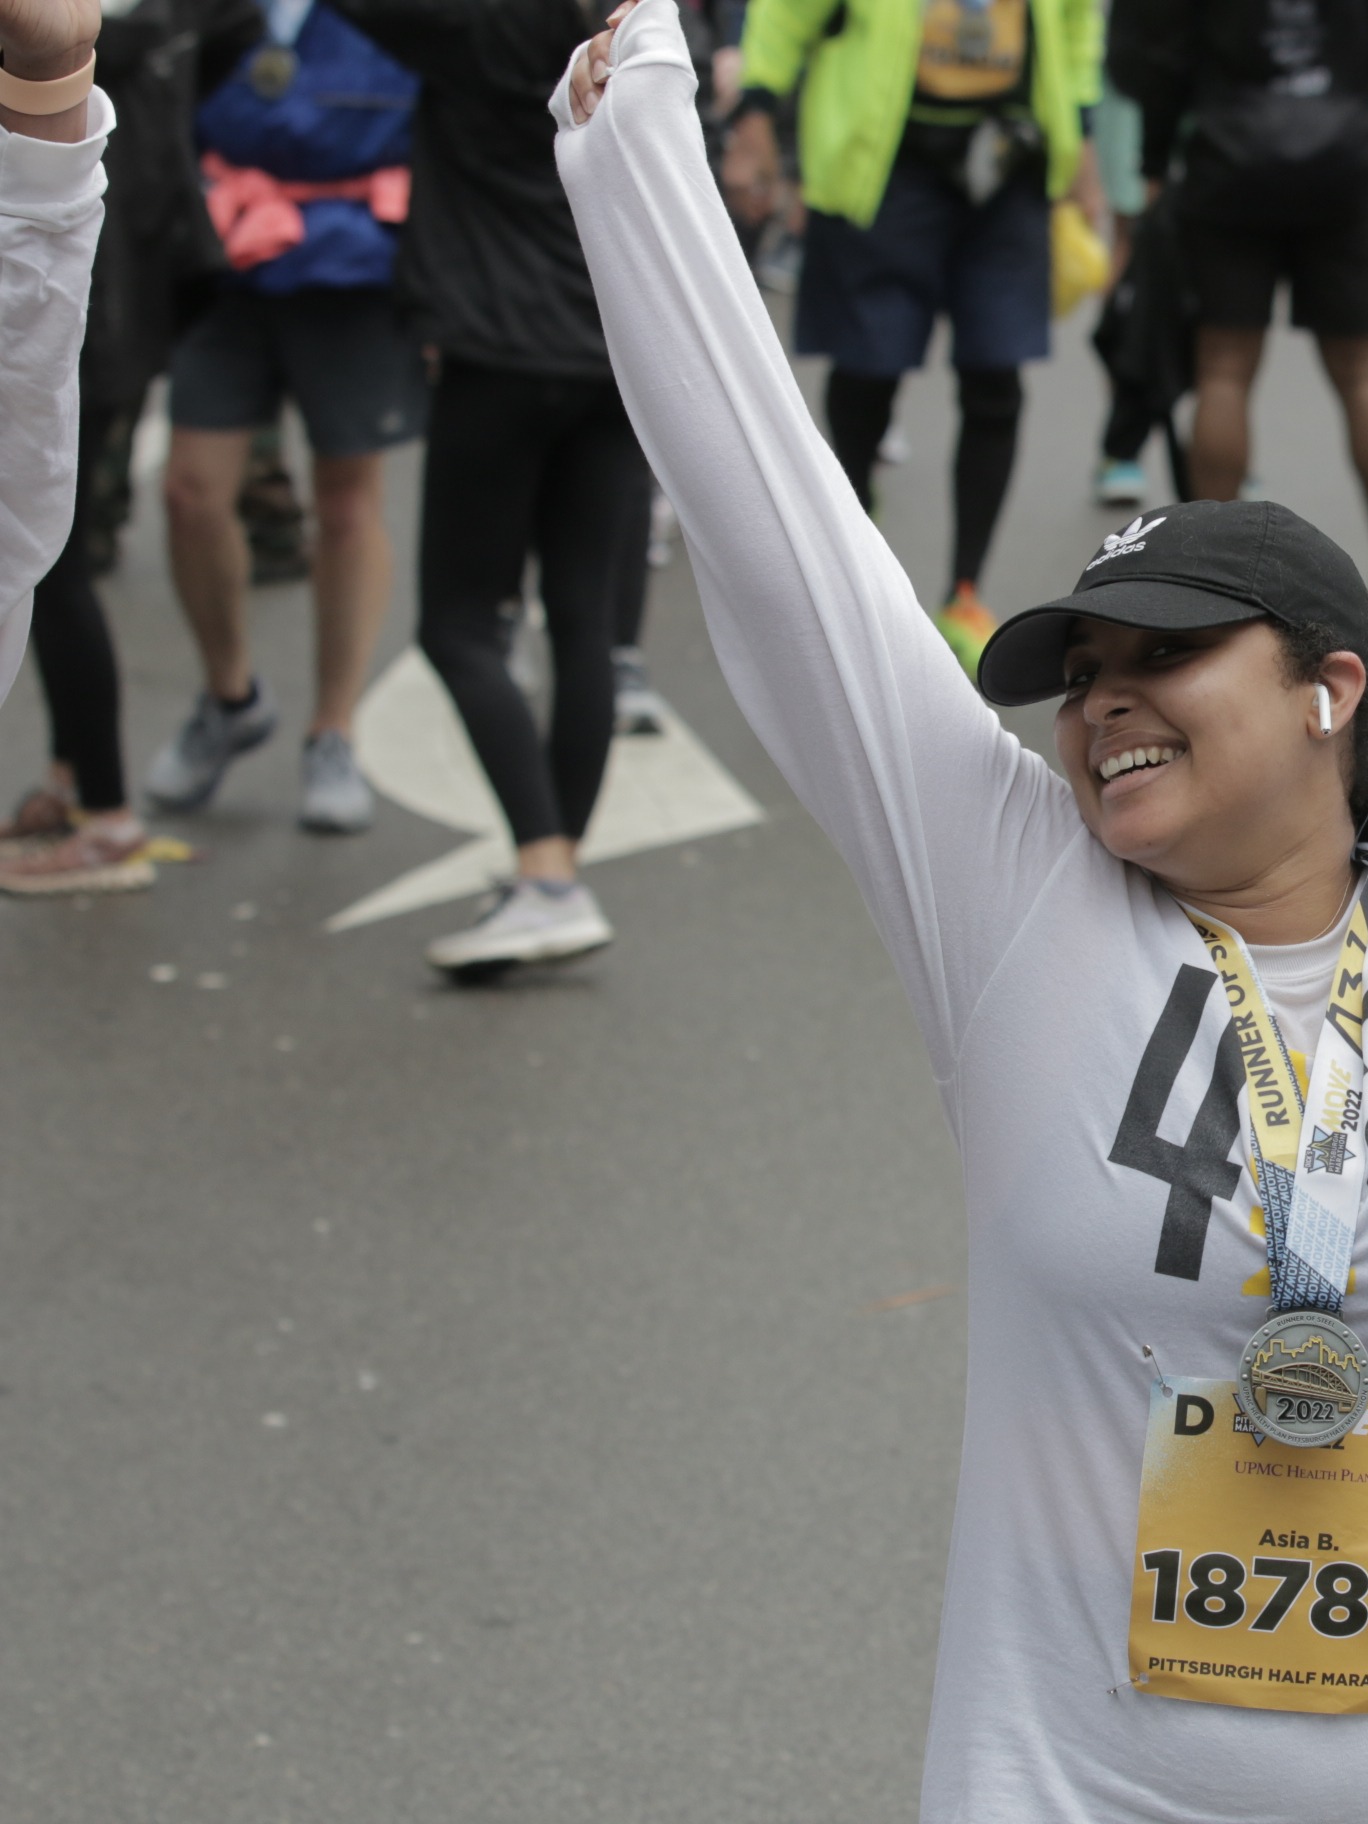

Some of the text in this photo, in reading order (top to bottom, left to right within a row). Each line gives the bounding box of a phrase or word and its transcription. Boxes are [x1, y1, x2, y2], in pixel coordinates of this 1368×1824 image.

[1086, 541, 1146, 571] adidas
[1235, 1010, 1290, 1127] RUNNER
[1320, 1058, 1352, 1133] MOVE
[1341, 1089, 1363, 1132] 2022
[1328, 1133, 1340, 1172] PITTSBURGH
[1335, 1134, 1346, 1173] MARATHON
[1285, 1254, 1299, 1288] MOVE
[1296, 1261, 1310, 1296] MOVE
[1307, 1269, 1320, 1304] MOVE
[1276, 1315, 1304, 1327] RUNNER
[1317, 1316, 1336, 1328] STEEL
[1174, 1393, 1215, 1436] D
[1251, 1407, 1271, 1430] HEALTH
[1270, 1426, 1288, 1439] PLAN
[1287, 1431, 1330, 1443] PITTSBURGH
[1330, 1422, 1346, 1438] HALF
[1344, 1390, 1368, 1428] MARATHON
[1277, 1397, 1335, 1422] 2022
[1234, 1460, 1284, 1477] UPMC
[1287, 1464, 1337, 1481] HEALTH
[1259, 1529, 1339, 1552] Asia B.
[1148, 1656, 1263, 1681] PITTSBURGH
[1268, 1668, 1317, 1685] HALF
